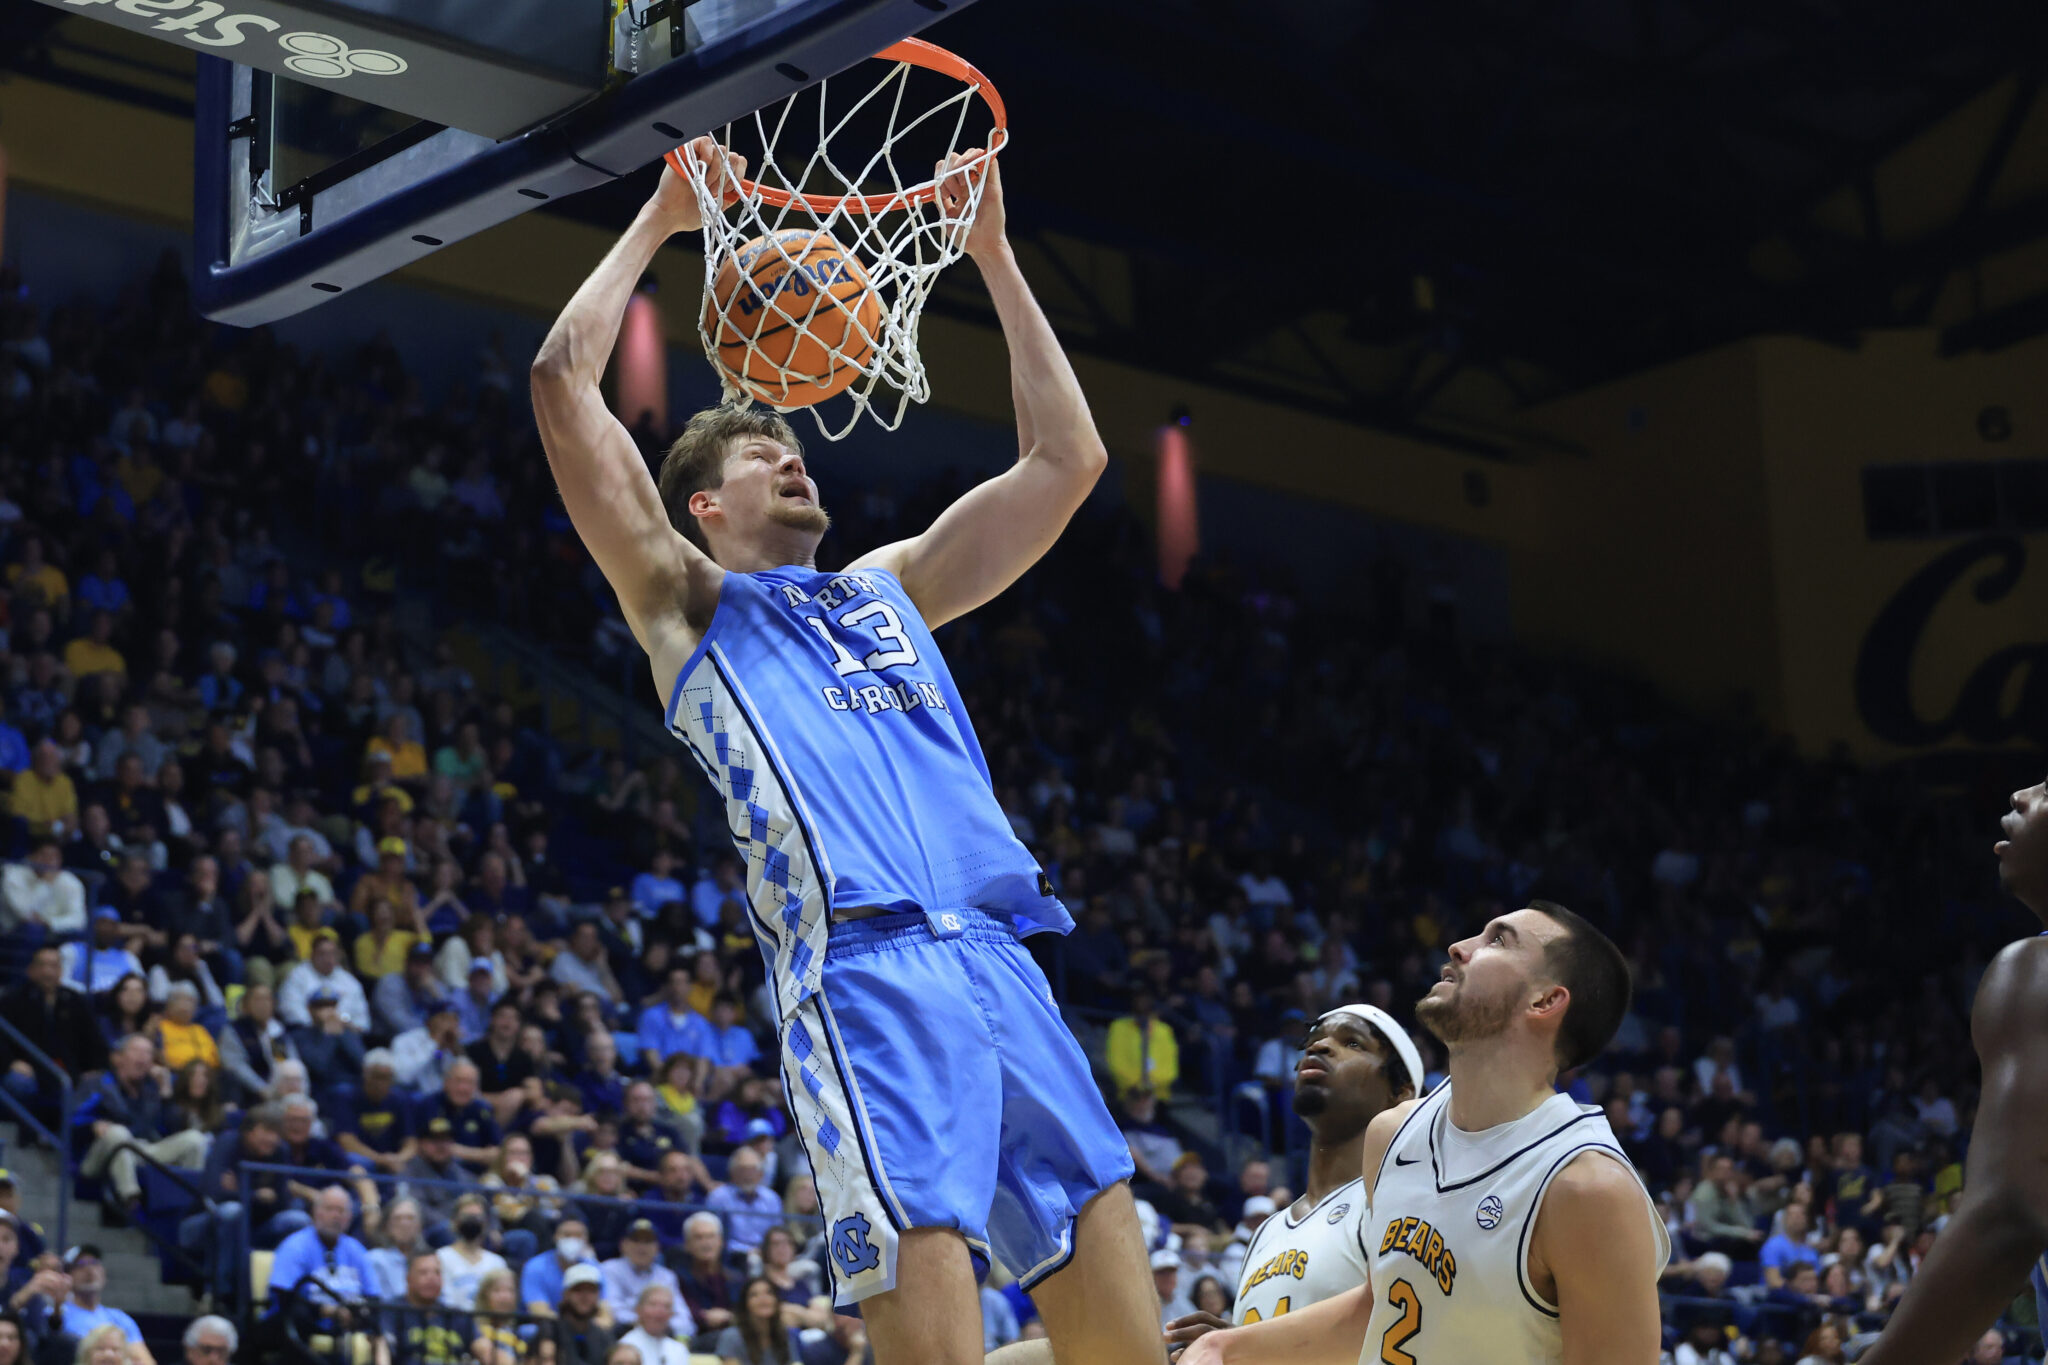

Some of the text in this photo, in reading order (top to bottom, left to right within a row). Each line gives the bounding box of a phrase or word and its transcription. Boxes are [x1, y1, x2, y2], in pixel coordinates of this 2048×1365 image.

[781, 575, 883, 612] NRTH
[806, 599, 920, 677] 13
[1480, 1205, 1502, 1219] ACC
[1240, 1248, 1309, 1302] BEARS
[1379, 1216, 1457, 1297] BEARS
[1381, 1277, 1423, 1365] 2
